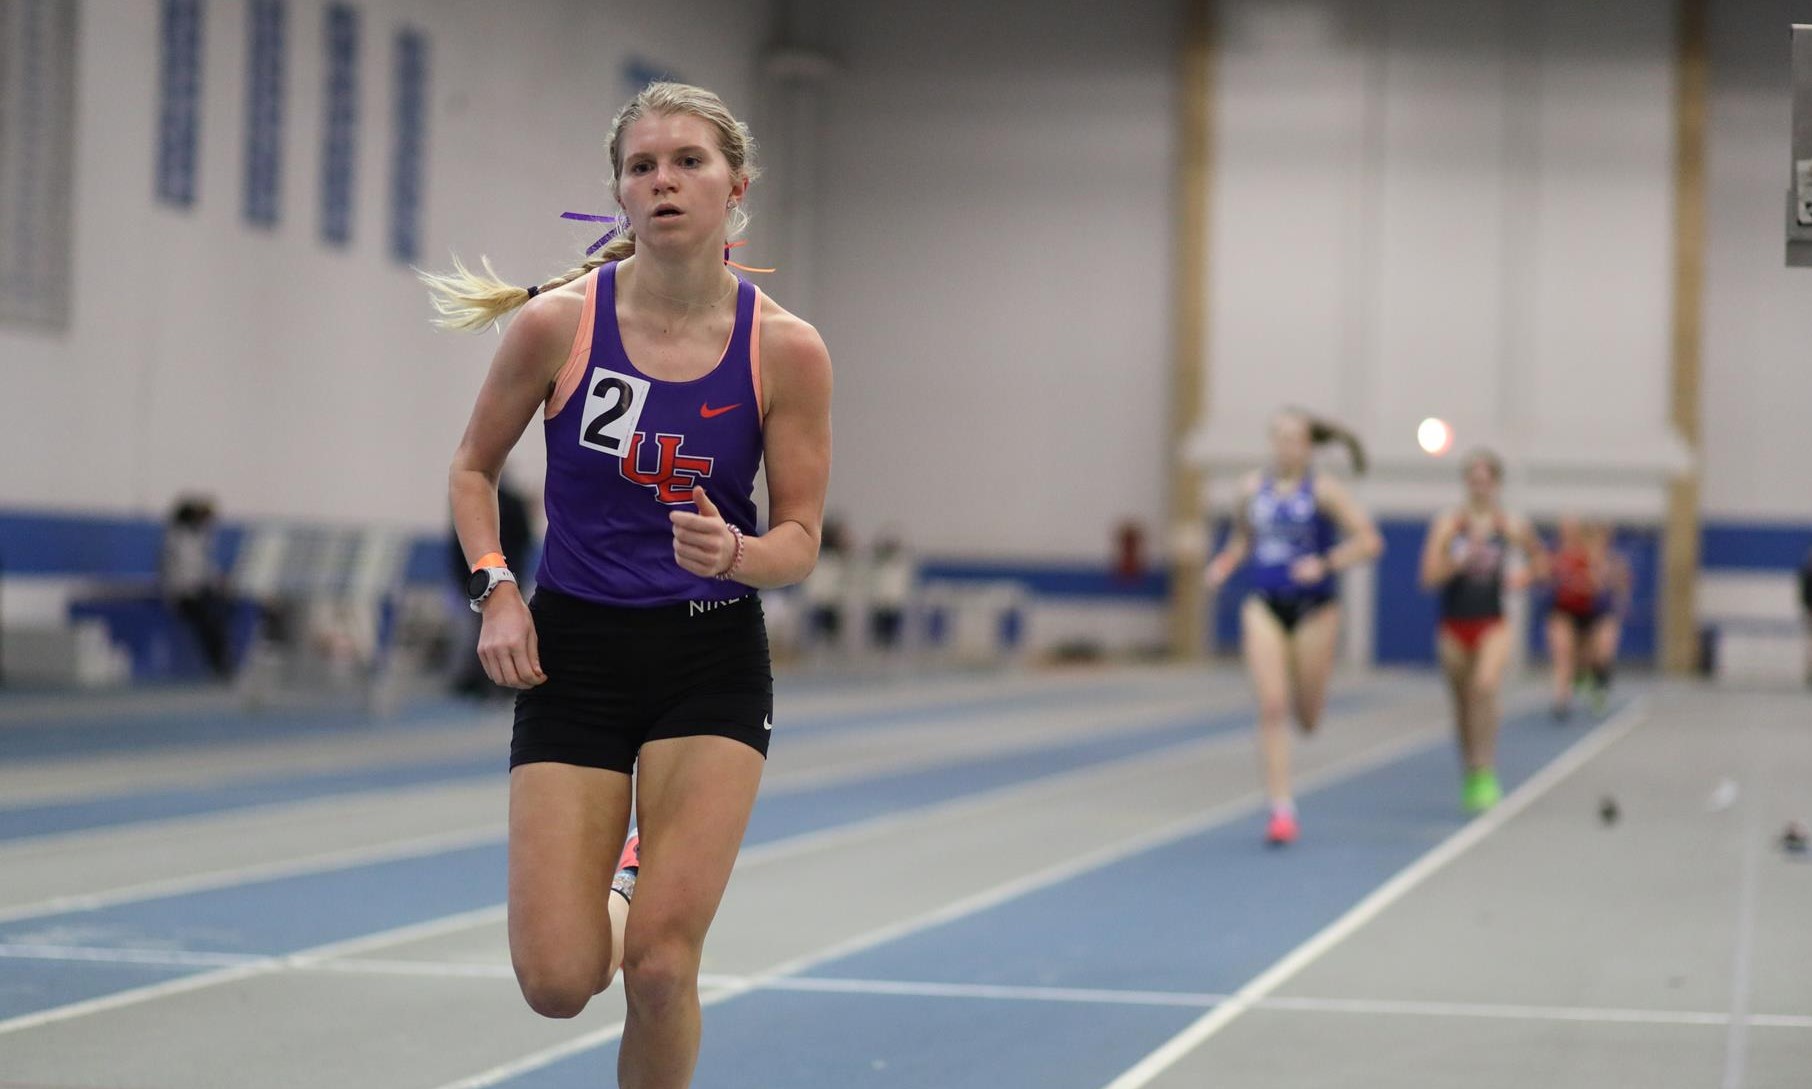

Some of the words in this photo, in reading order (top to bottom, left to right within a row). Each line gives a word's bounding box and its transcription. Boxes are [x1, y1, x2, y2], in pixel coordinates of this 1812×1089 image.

[583, 377, 634, 450] 2
[619, 431, 714, 505] UE
[689, 598, 740, 617] NI
